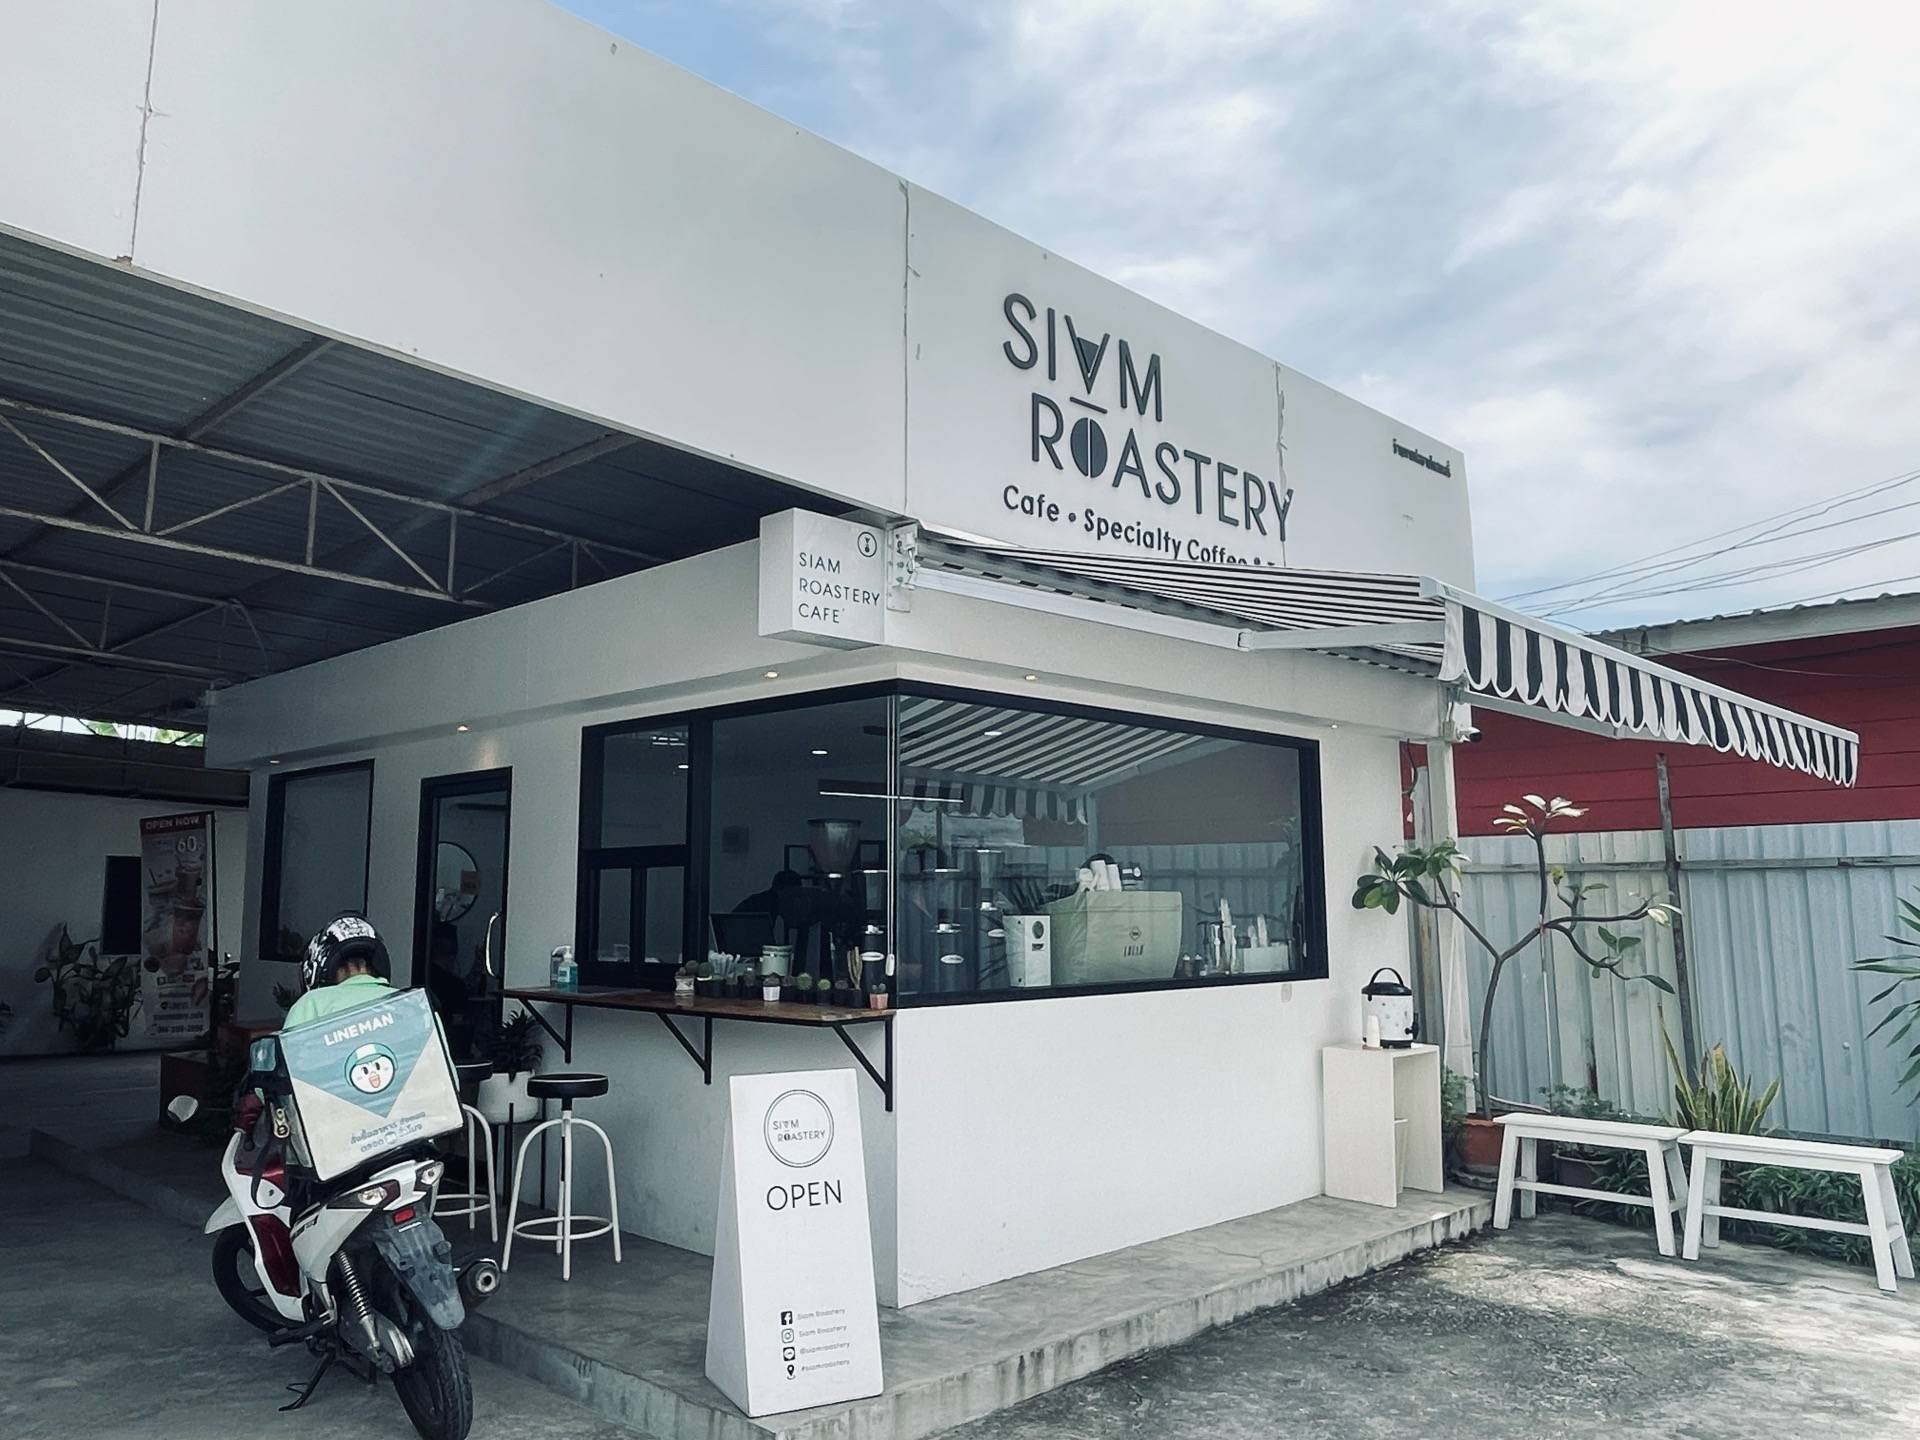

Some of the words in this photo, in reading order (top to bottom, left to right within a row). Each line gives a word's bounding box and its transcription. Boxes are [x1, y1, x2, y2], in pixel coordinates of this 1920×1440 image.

[1032, 392, 1293, 541] ROASTERY
[1003, 485, 1060, 522] Cafe
[1084, 508, 1182, 560] Specialty
[799, 552, 841, 575] SIAM
[799, 578, 880, 606] ROASTERY
[777, 1130, 825, 1142] ROASTERY
[766, 1179, 842, 1211] OPEN
